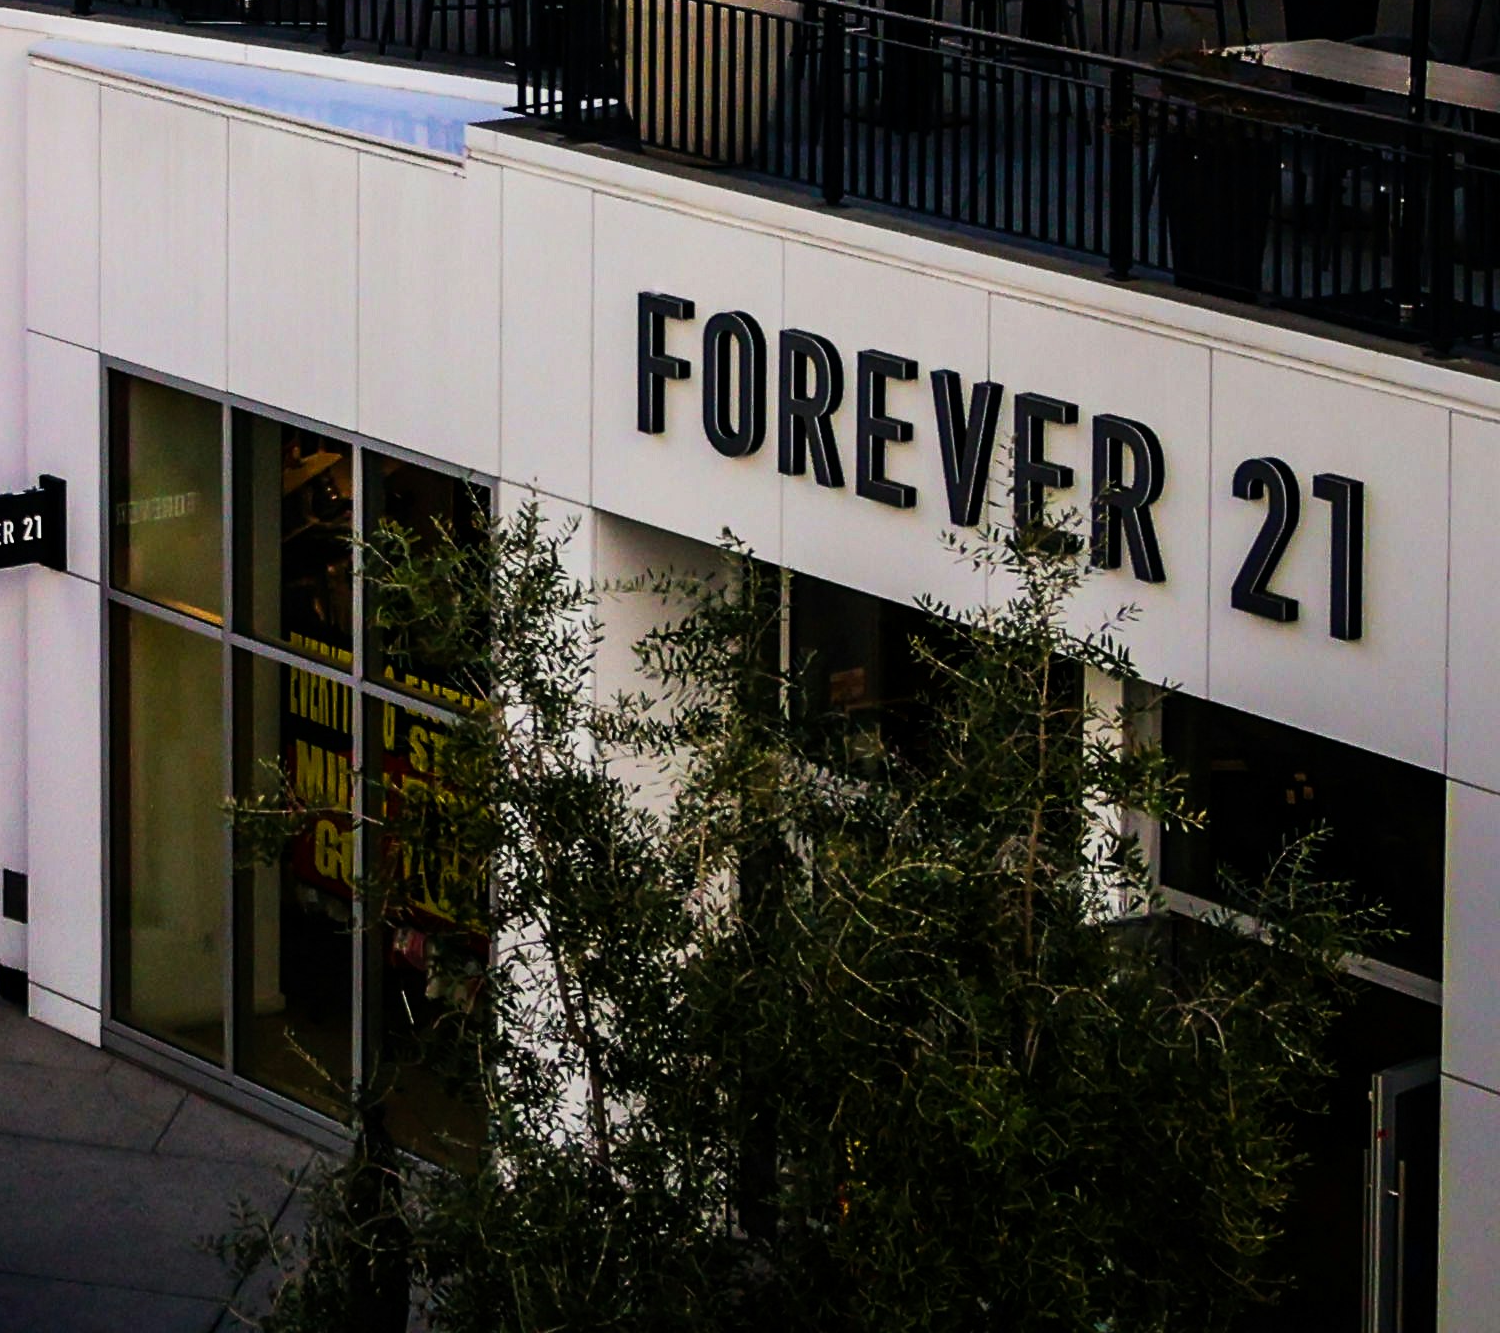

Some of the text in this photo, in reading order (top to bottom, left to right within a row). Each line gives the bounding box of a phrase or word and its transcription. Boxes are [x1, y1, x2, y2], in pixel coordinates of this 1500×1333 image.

[22, 514, 43, 541] 21
[636, 290, 1366, 643] FOREVER 21
